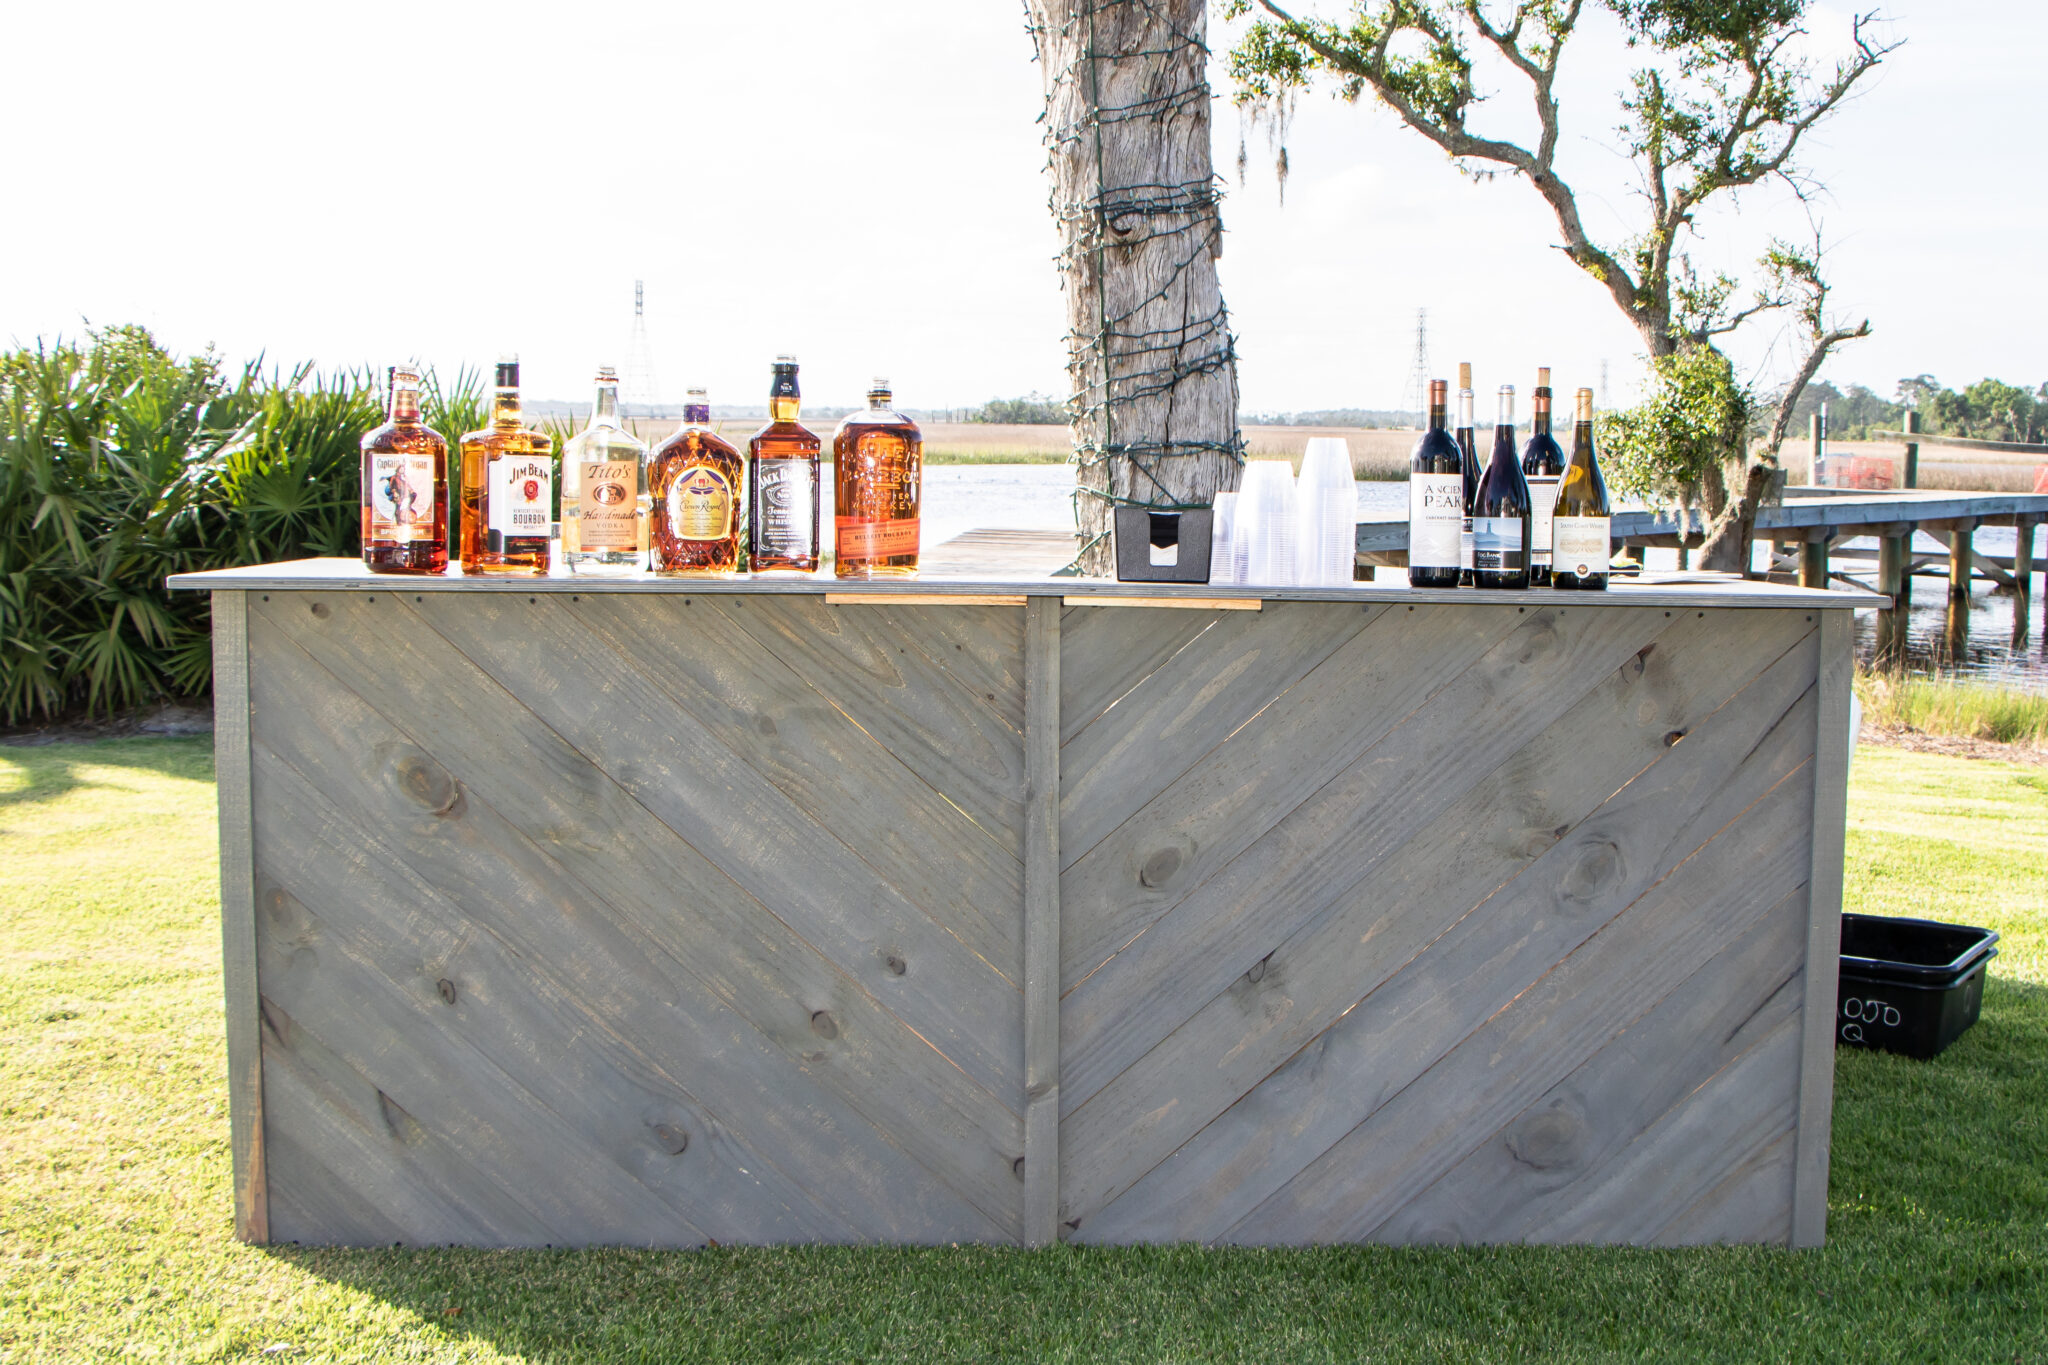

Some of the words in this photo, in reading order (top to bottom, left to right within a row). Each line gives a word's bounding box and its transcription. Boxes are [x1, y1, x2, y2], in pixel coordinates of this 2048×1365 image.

[509, 466, 527, 484] JIM
[528, 463, 549, 484] BEAM
[588, 464, 631, 479] Tito's
[1424, 484, 1462, 494] ANCIEN
[679, 499, 700, 513] Crown
[699, 499, 724, 513] Royal
[1424, 495, 1462, 508] PEAK
[513, 513, 546, 524] BOURBON
[583, 509, 636, 520] Handmade
[1837, 996, 1901, 1027] OJO
